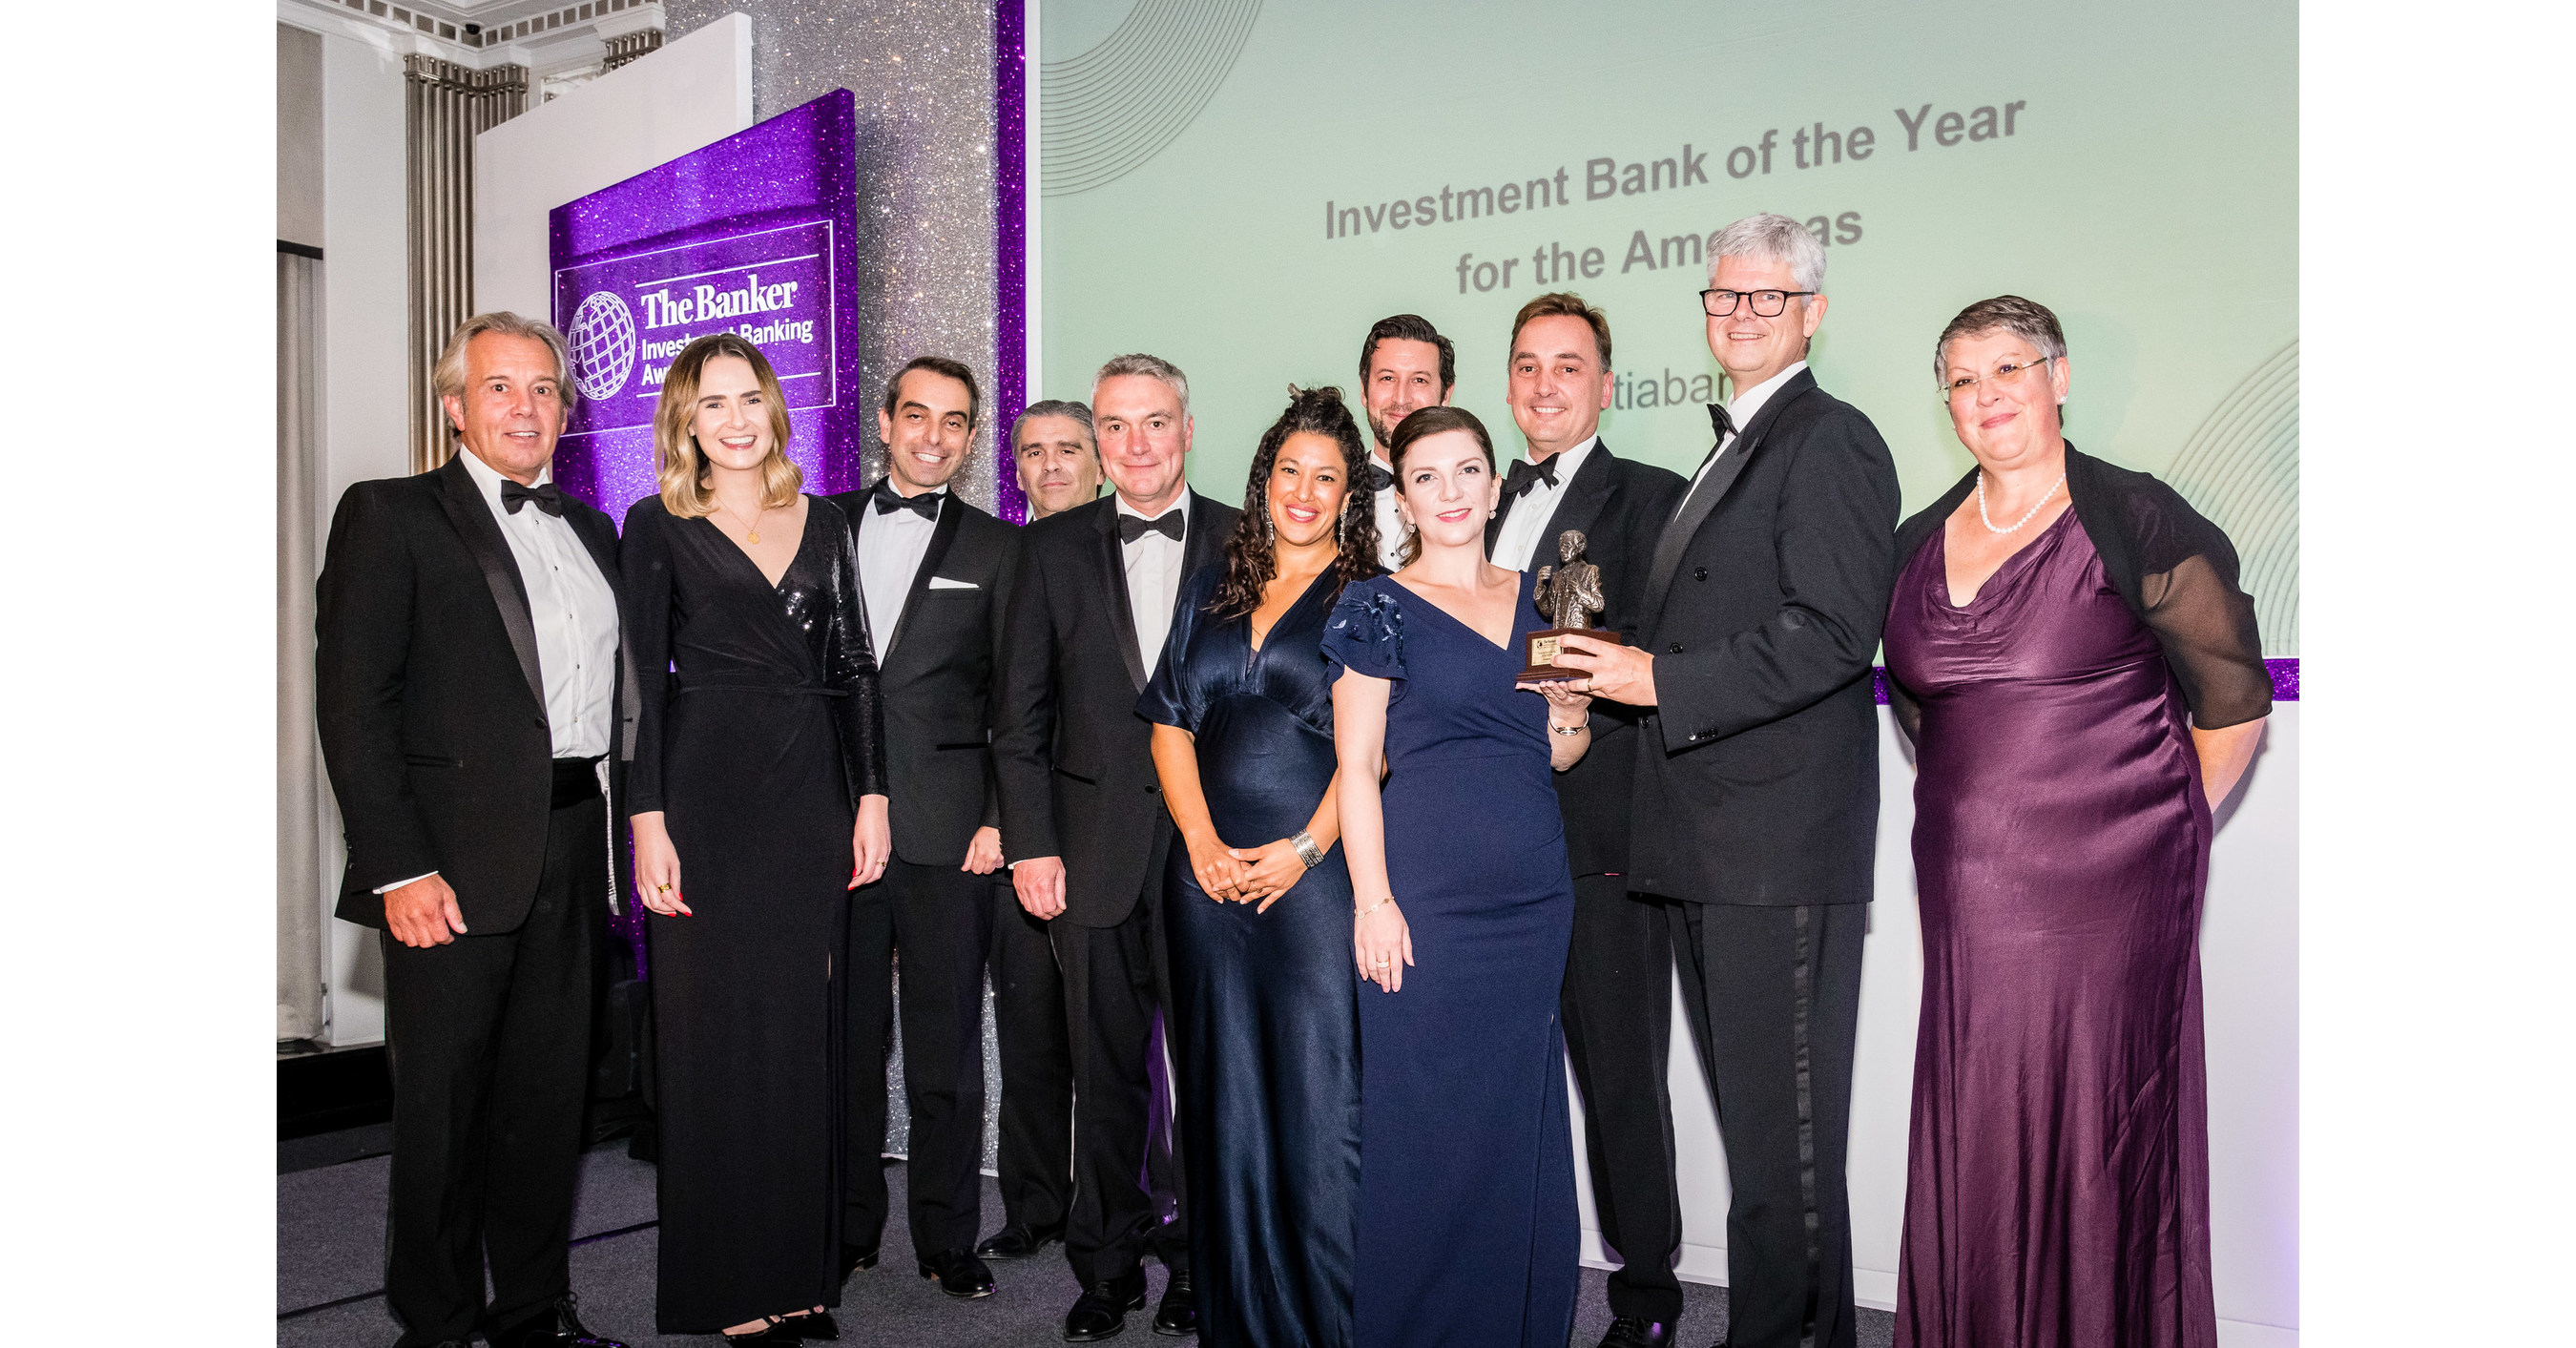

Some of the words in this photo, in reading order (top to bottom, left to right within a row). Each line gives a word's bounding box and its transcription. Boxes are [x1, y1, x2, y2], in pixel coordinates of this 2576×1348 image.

[1326, 165, 1569, 239] Investment
[1586, 144, 1709, 201] Bank
[1726, 129, 1778, 179] of
[1792, 122, 1875, 170] the
[1893, 100, 2026, 152] Year
[1456, 253, 1519, 294] for
[1532, 241, 1605, 285] the
[1621, 211, 1863, 274] Amas
[641, 287, 694, 330] The
[694, 273, 798, 322] Banker
[642, 326, 737, 361] Invest
[740, 318, 814, 344] Banking
